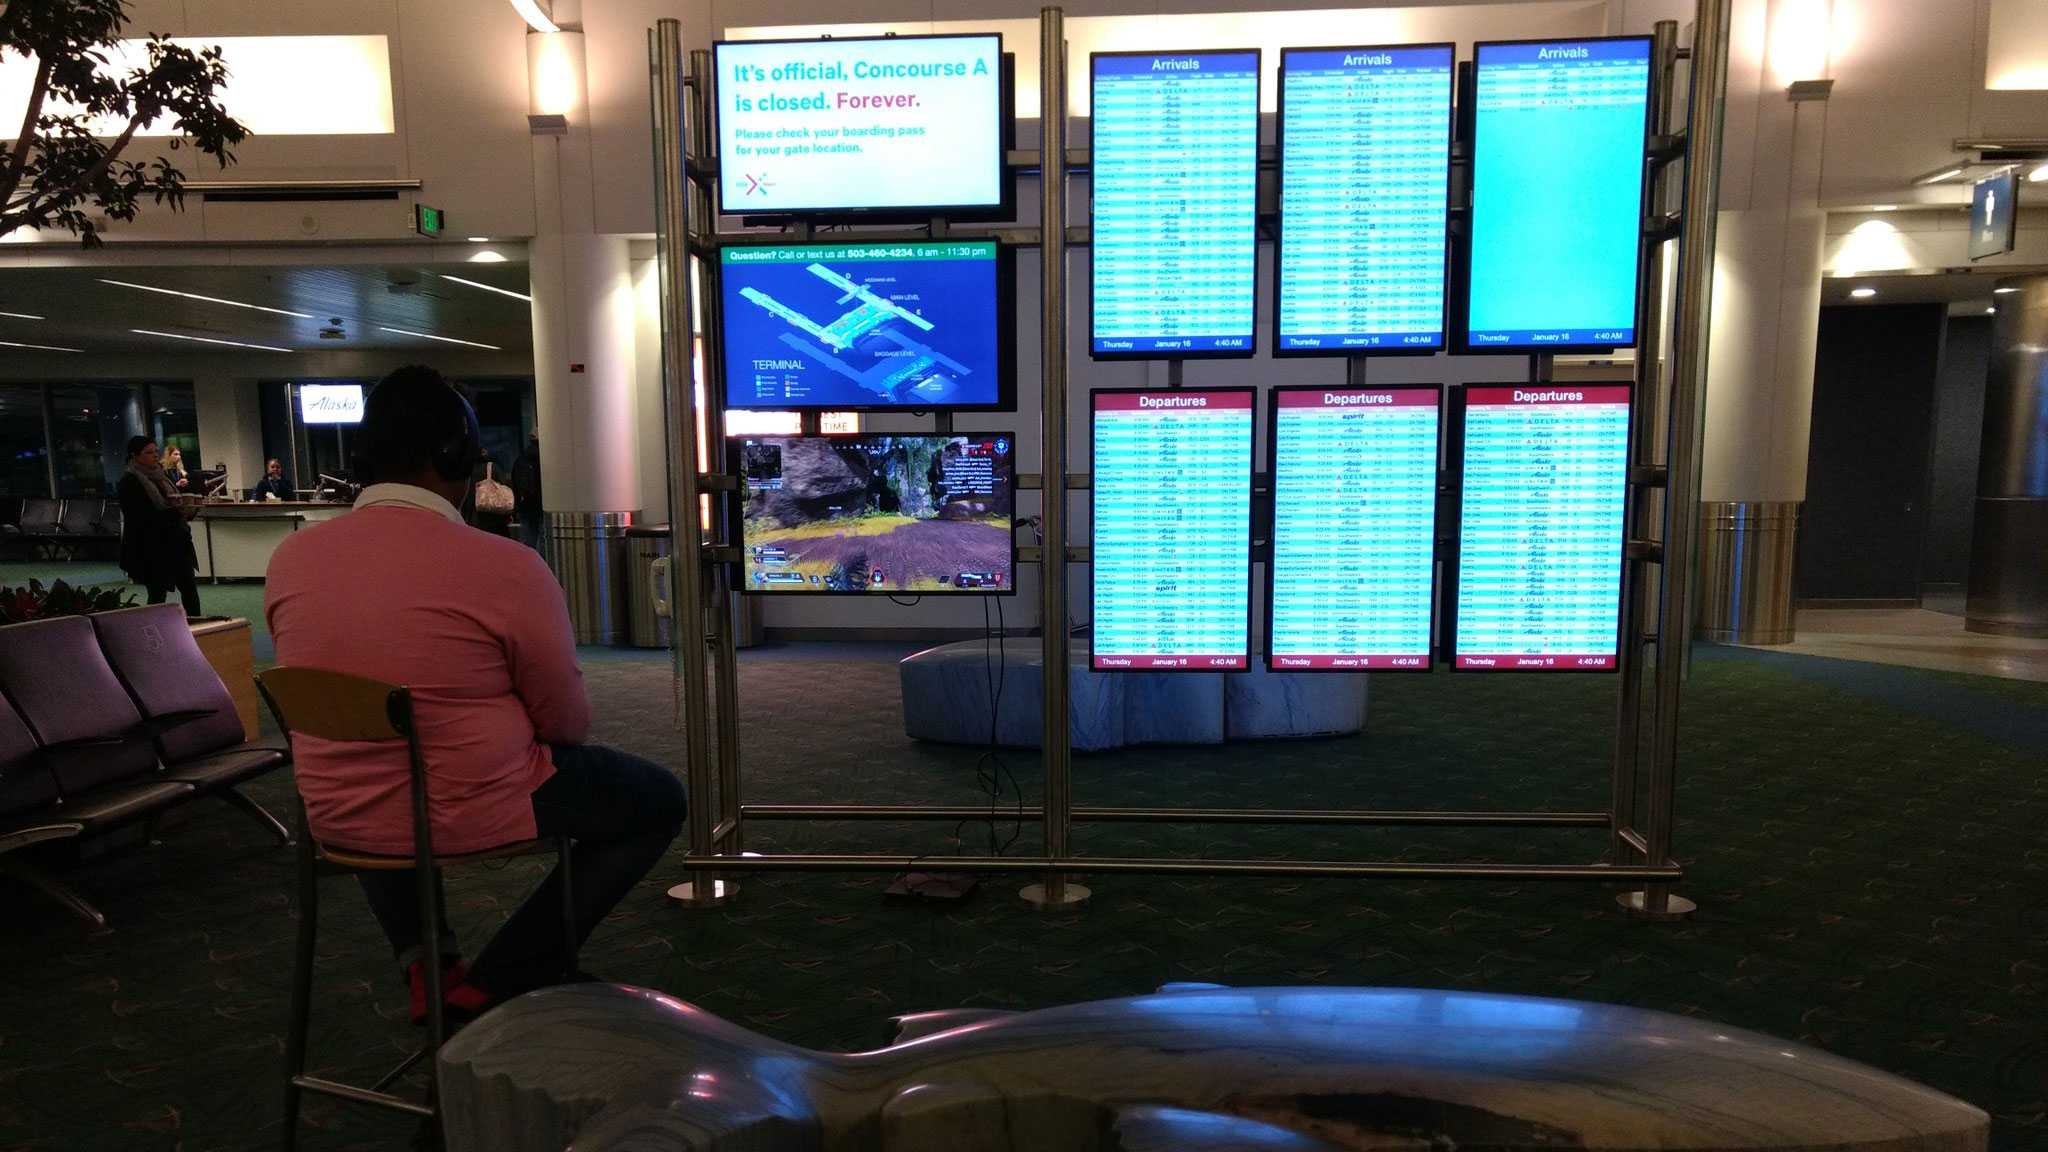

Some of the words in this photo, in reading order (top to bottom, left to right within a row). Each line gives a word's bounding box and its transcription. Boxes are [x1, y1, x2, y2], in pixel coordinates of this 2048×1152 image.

[1538, 47, 1588, 59] Arrivals
[1152, 59, 1200, 71] Arrivals
[1344, 54, 1392, 66] Arrivals
[735, 64, 764, 82] It's
[772, 62, 848, 82] official,
[854, 60, 966, 79] Concourse
[974, 58, 987, 75] A
[736, 95, 752, 112] is
[758, 92, 831, 111] closed.
[837, 92, 920, 109] Forever.
[735, 129, 772, 139] Please
[776, 128, 809, 138] check
[814, 128, 839, 140] your
[843, 125, 894, 139] boarding
[898, 126, 925, 137] pass
[736, 145, 752, 156] for
[755, 145, 780, 156] your
[784, 144, 809, 156] gate
[813, 142, 862, 153] location.
[730, 251, 776, 261] Question?
[778, 250, 794, 259] Call
[807, 250, 822, 259] text
[947, 248, 970, 256] 11:30
[972, 248, 986, 257] pm
[1155, 340, 1181, 348] January
[1342, 338, 1369, 346] January
[1478, 334, 1509, 342] Thursday
[1532, 334, 1559, 342] January
[752, 360, 805, 370] TERMINAL
[1139, 396, 1206, 408] Departures
[1324, 393, 1392, 405] Departures
[1514, 391, 1583, 403] Departures
[308, 396, 357, 412] Alaska
[824, 422, 848, 432] TIME
